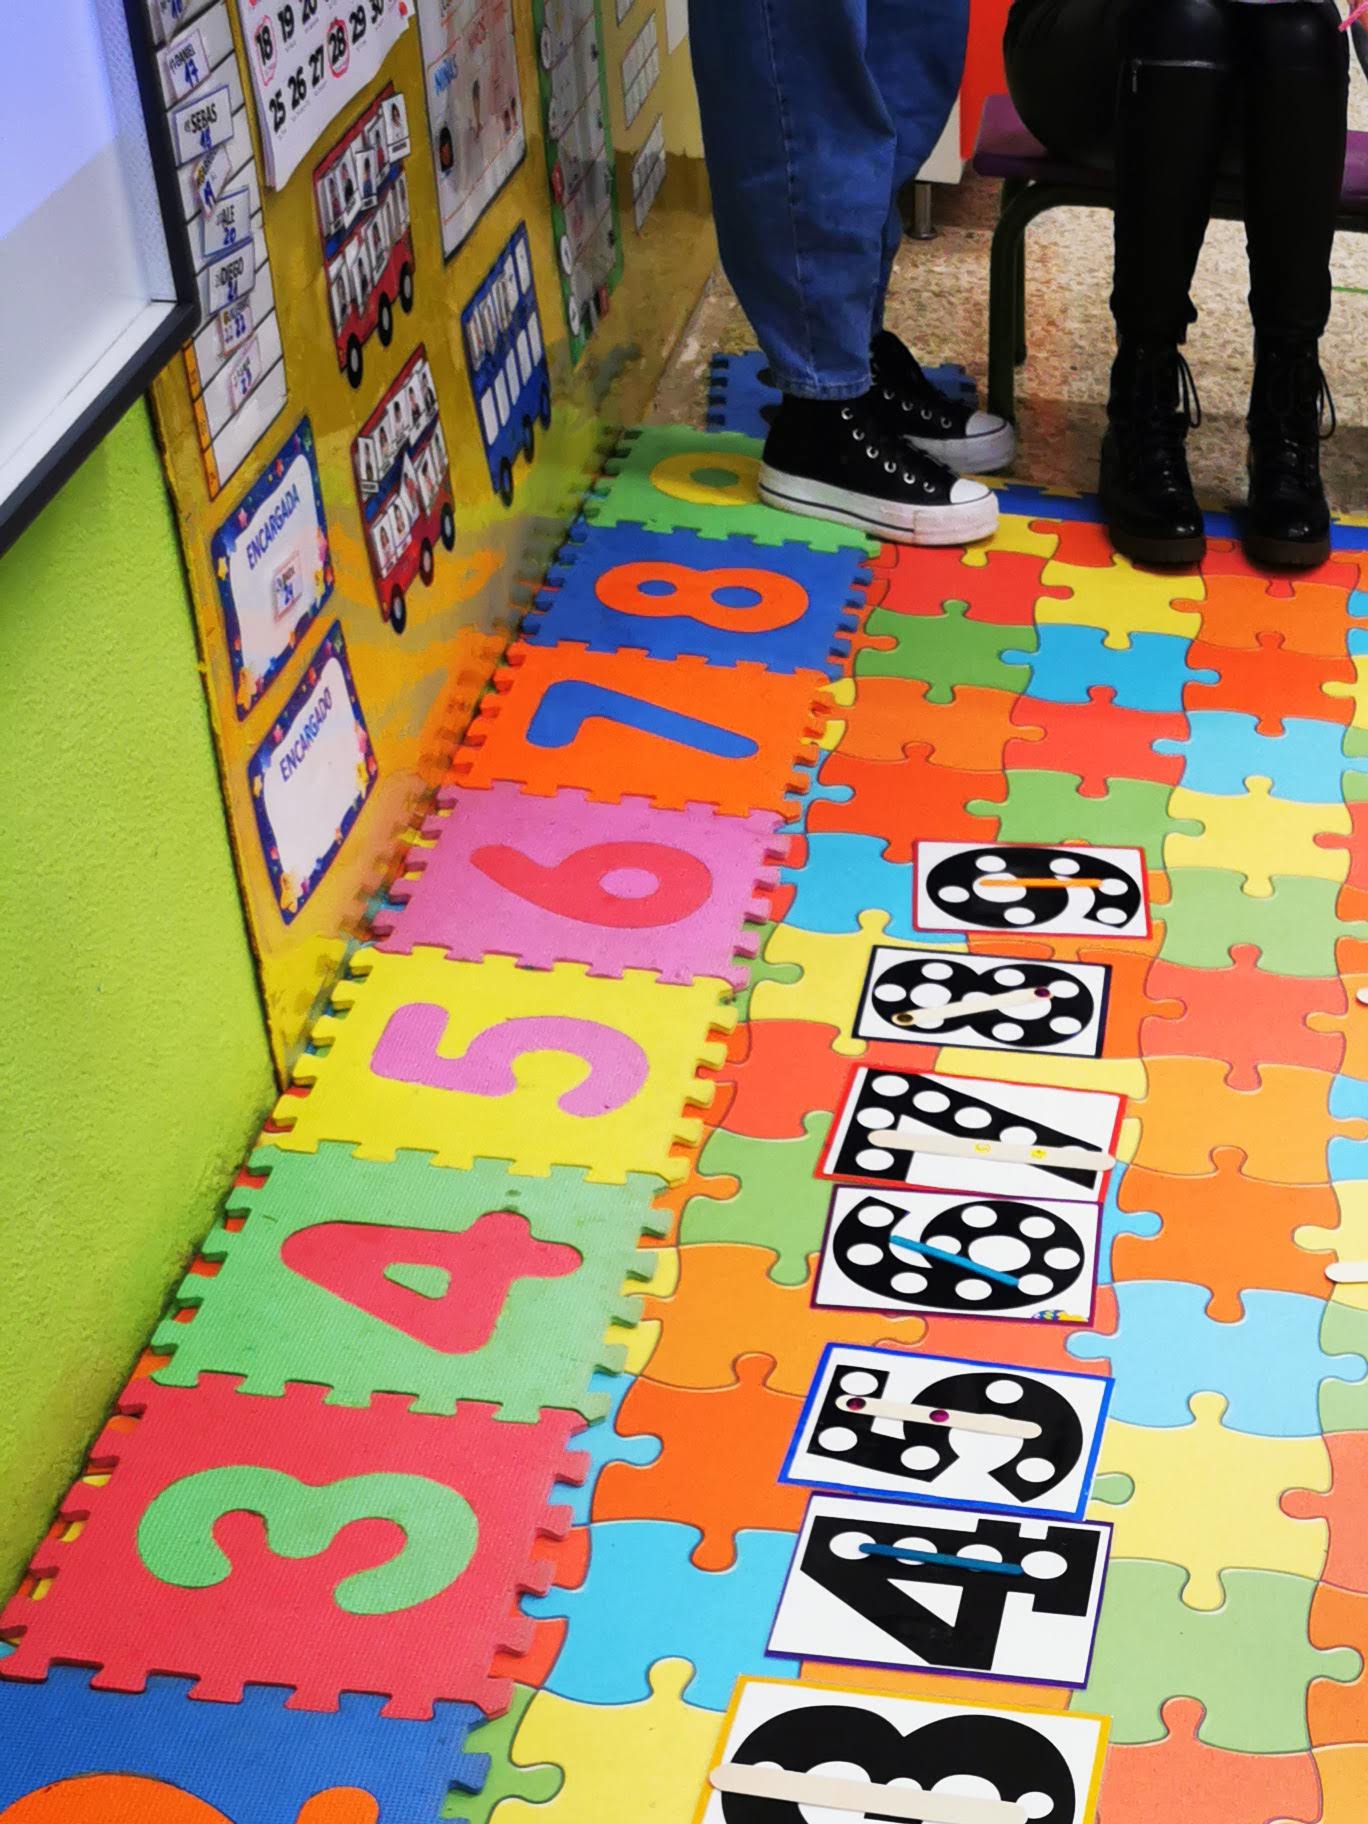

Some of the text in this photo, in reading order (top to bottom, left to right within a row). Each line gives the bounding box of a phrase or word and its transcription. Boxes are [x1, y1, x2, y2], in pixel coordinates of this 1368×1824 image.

[256, 25, 273, 65] 18
[278, 4, 294, 42] 19
[269, 90, 286, 134] 25
[288, 66, 307, 111] 26
[308, 44, 325, 87] 27
[329, 25, 347, 66] 28
[349, 5, 366, 45] 29
[246, 483, 300, 570] ENCARGADA
[595, 561, 809, 633] 8
[280, 686, 332, 782] ENCARGADO
[526, 680, 759, 759] 7
[470, 841, 713, 928] 6
[926, 846, 1141, 928] 9
[872, 959, 1094, 1047] 8
[371, 1003, 650, 1117] 5
[833, 1069, 1102, 1190] 7
[281, 1210, 583, 1355] 4
[833, 1196, 1085, 1311] 6
[807, 1364, 1083, 1502] 5
[137, 1465, 479, 1615] 3
[800, 1515, 1100, 1670] 4
